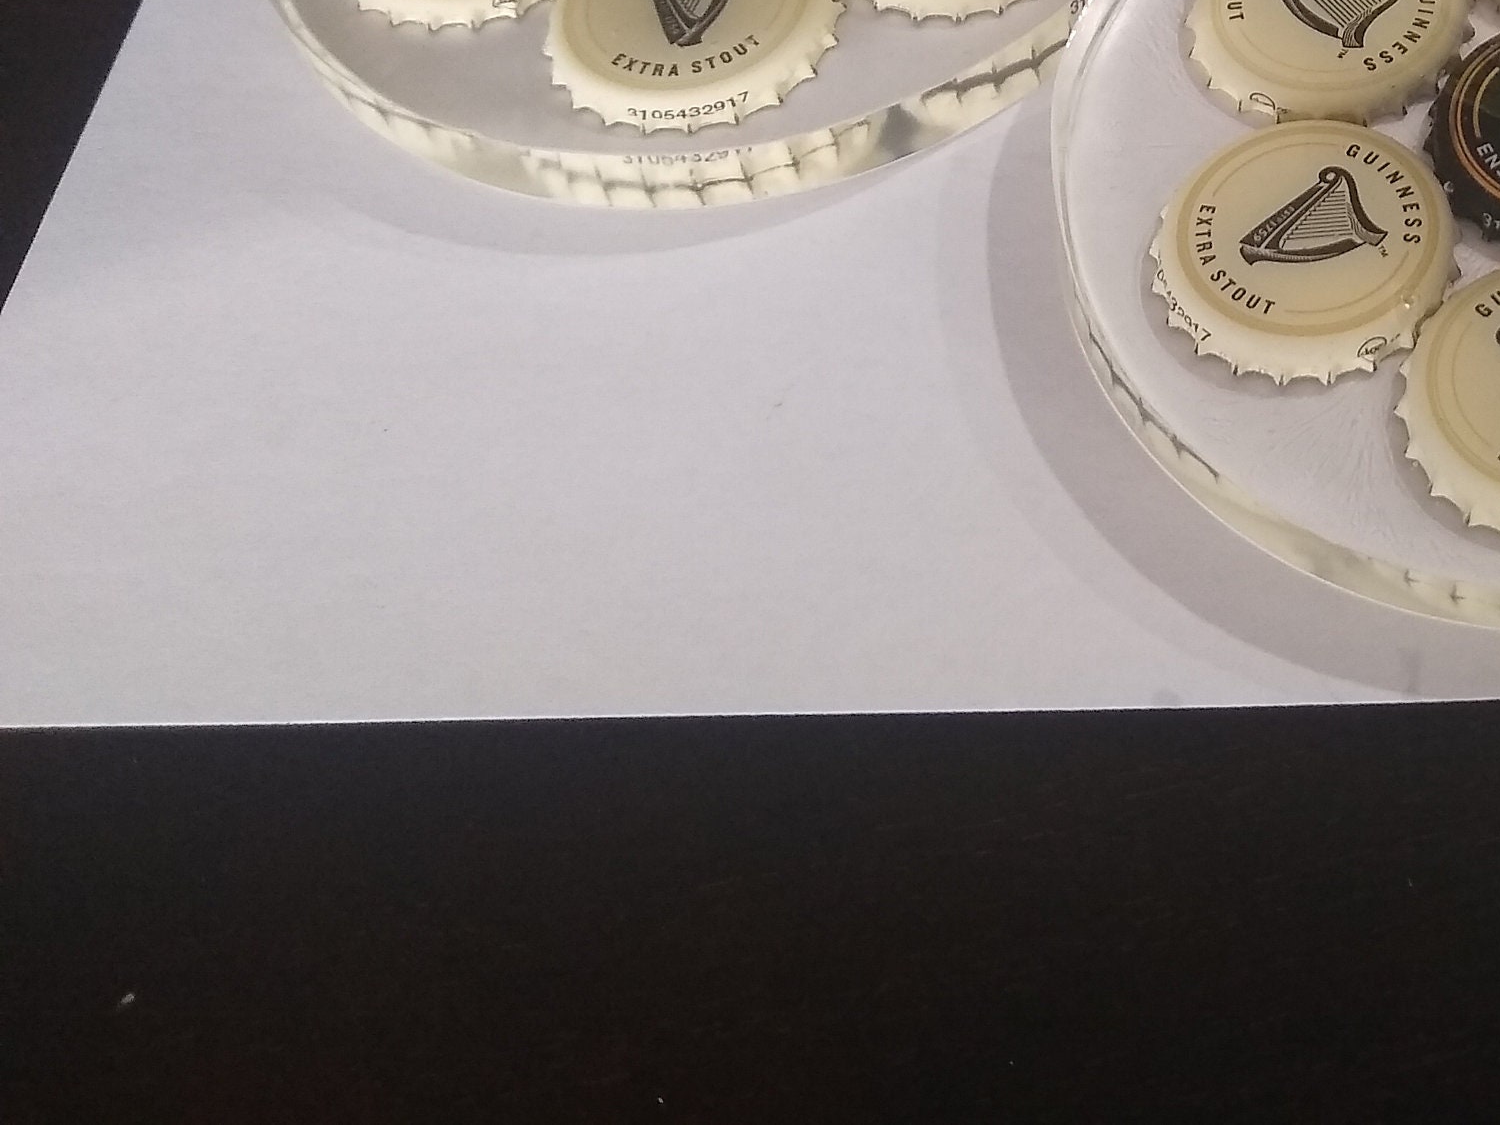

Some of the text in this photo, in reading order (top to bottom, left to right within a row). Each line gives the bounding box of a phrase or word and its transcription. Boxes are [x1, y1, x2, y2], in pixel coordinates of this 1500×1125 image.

[611, 35, 760, 77] EXTRA STOUT
[627, 91, 749, 121] 3105432917
[1346, 143, 1422, 245] GUINNESS
[1195, 204, 1276, 315] EXTRA STOUT
